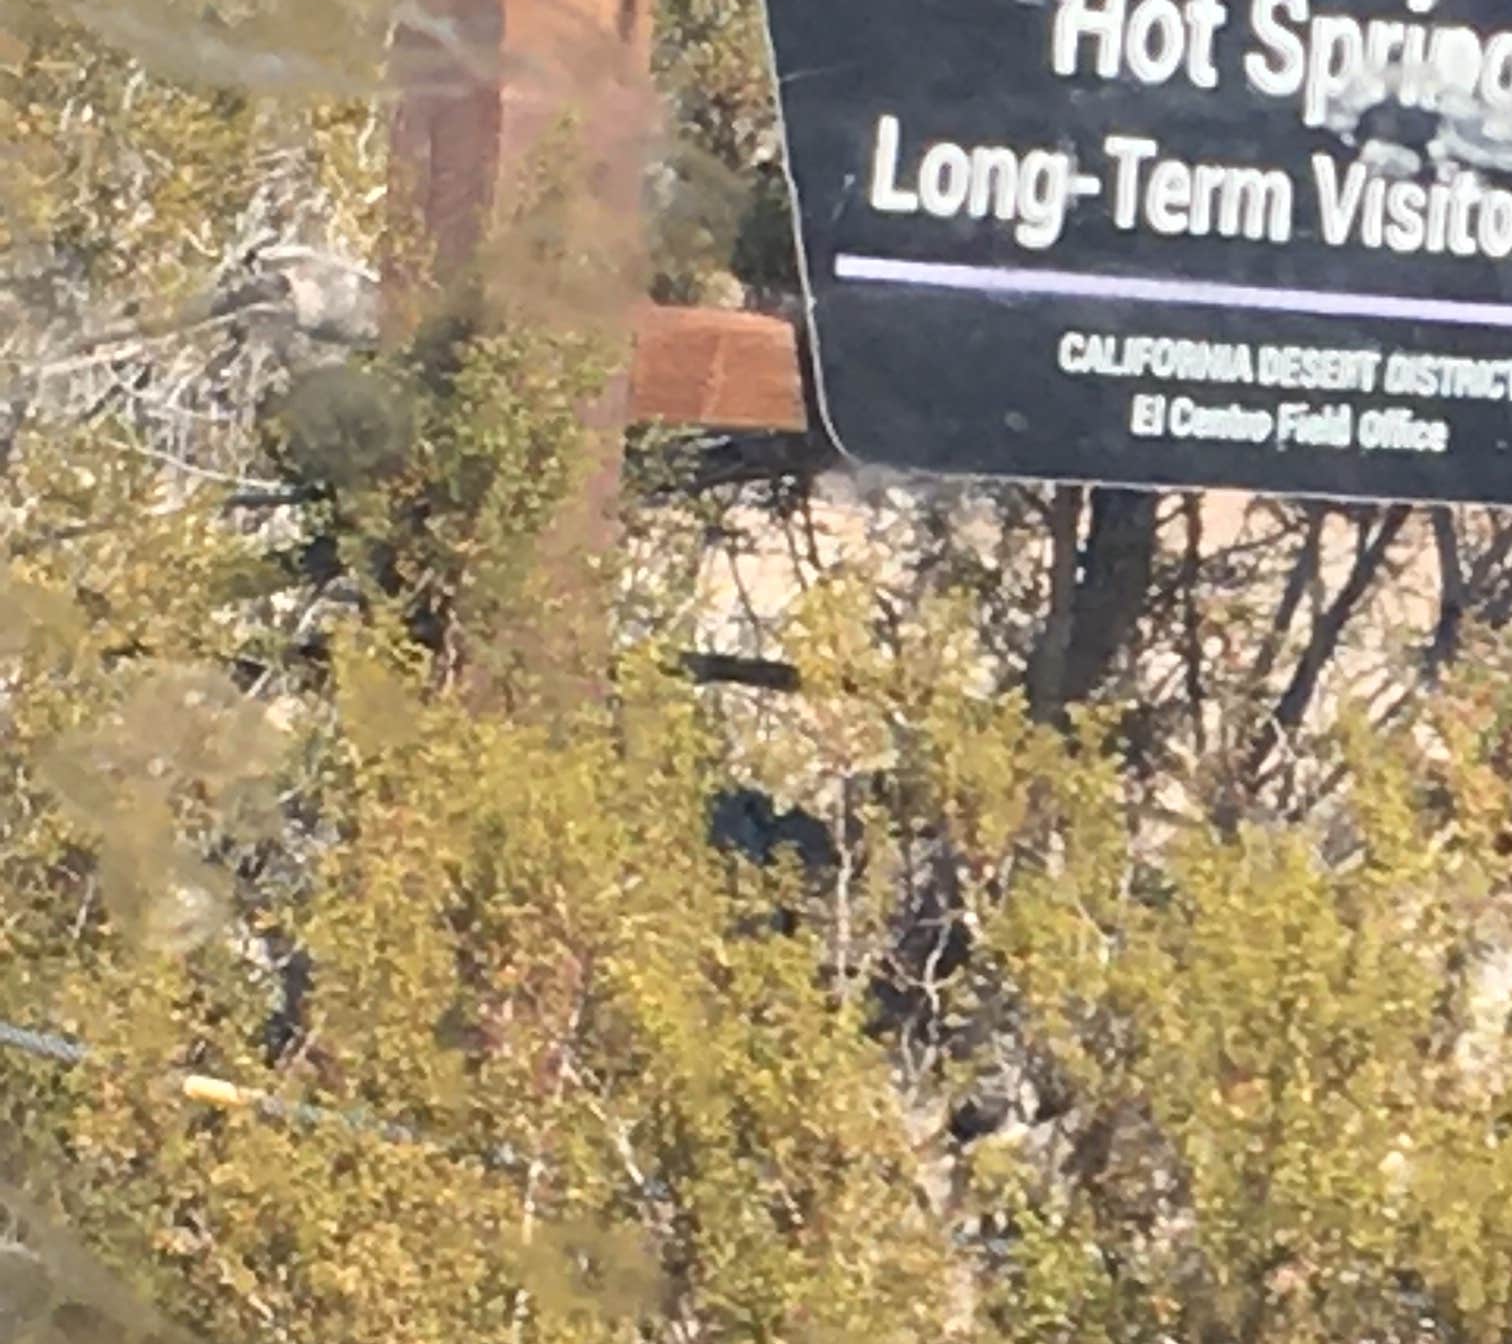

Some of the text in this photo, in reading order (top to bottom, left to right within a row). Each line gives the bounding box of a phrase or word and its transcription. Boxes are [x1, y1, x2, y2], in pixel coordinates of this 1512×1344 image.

[870, 114, 1293, 249] Long-Term
[1059, 331, 1253, 384] CALIFORNIA
[1258, 345, 1381, 393] DESERT
[1130, 393, 1450, 453] El Centro Field Office
